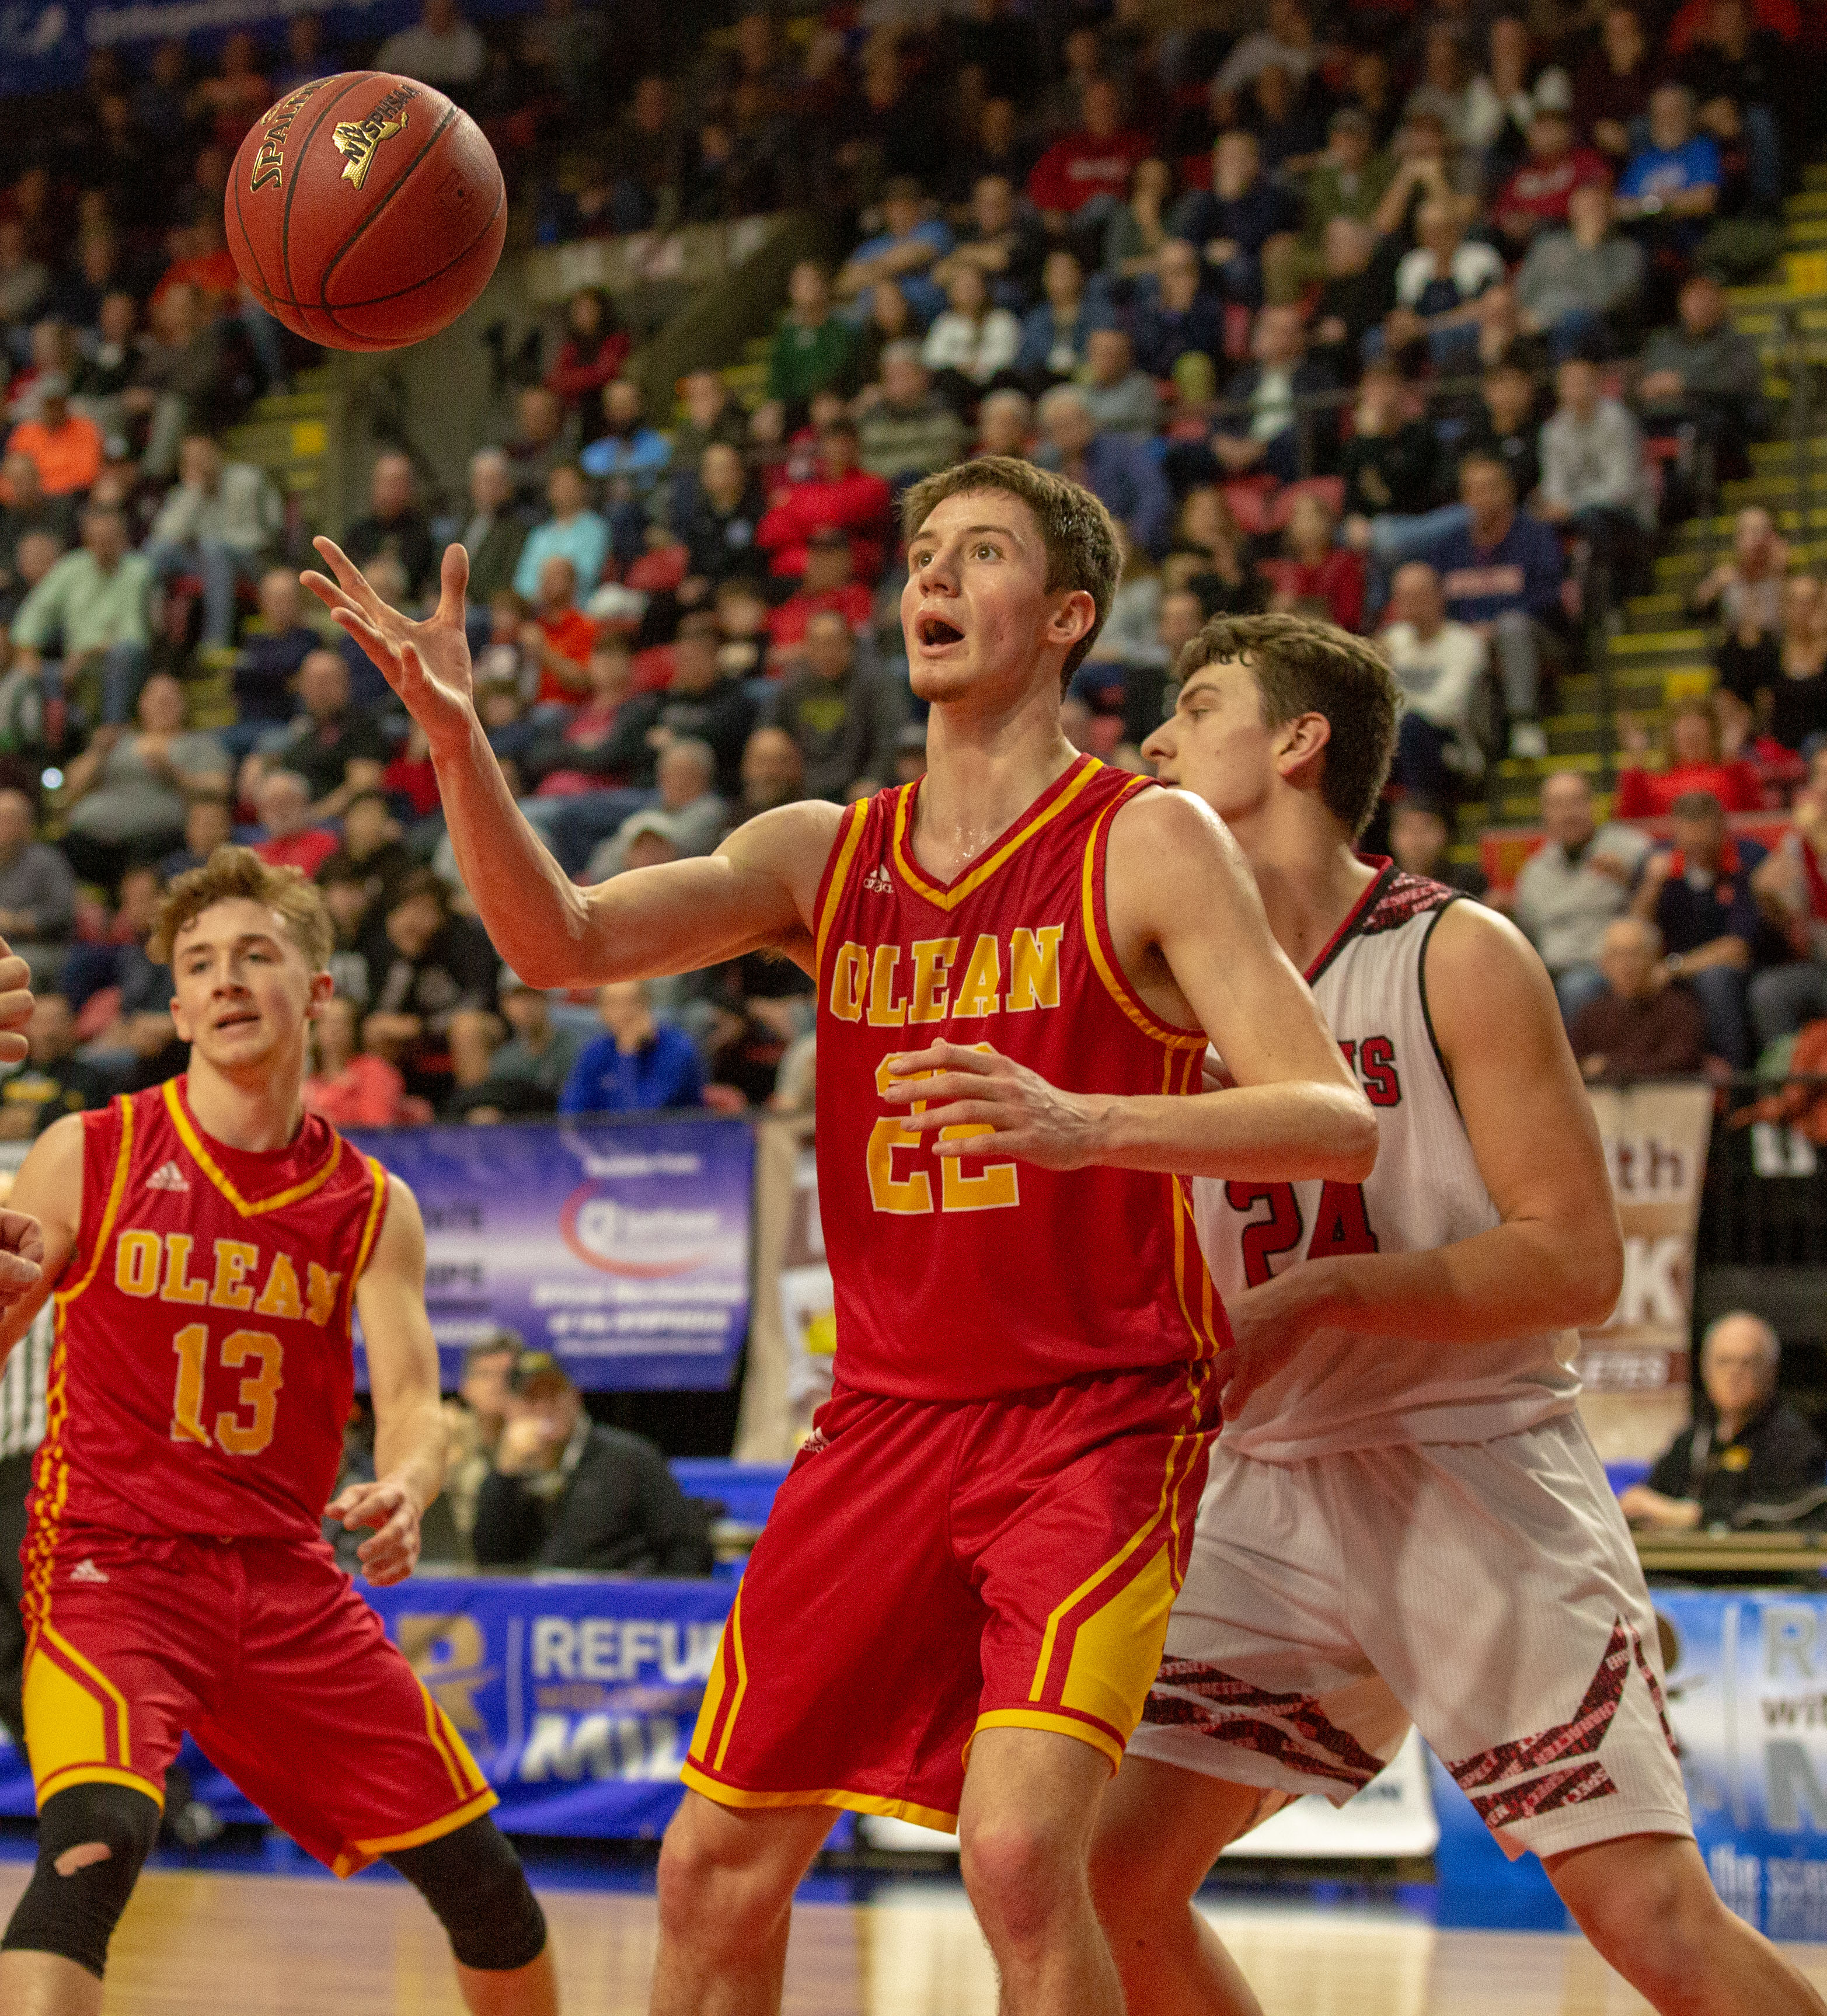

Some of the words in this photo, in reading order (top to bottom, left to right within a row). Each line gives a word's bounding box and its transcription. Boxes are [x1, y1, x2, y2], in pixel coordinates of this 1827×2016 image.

[343, 84, 421, 166] NYSPHSAA
[829, 923, 1065, 1027] OLEAN
[866, 1041, 1020, 1215] 22
[115, 1230, 344, 1328] OLEAN
[1225, 1179, 1379, 1288] 24
[170, 1322, 284, 1456] 13
